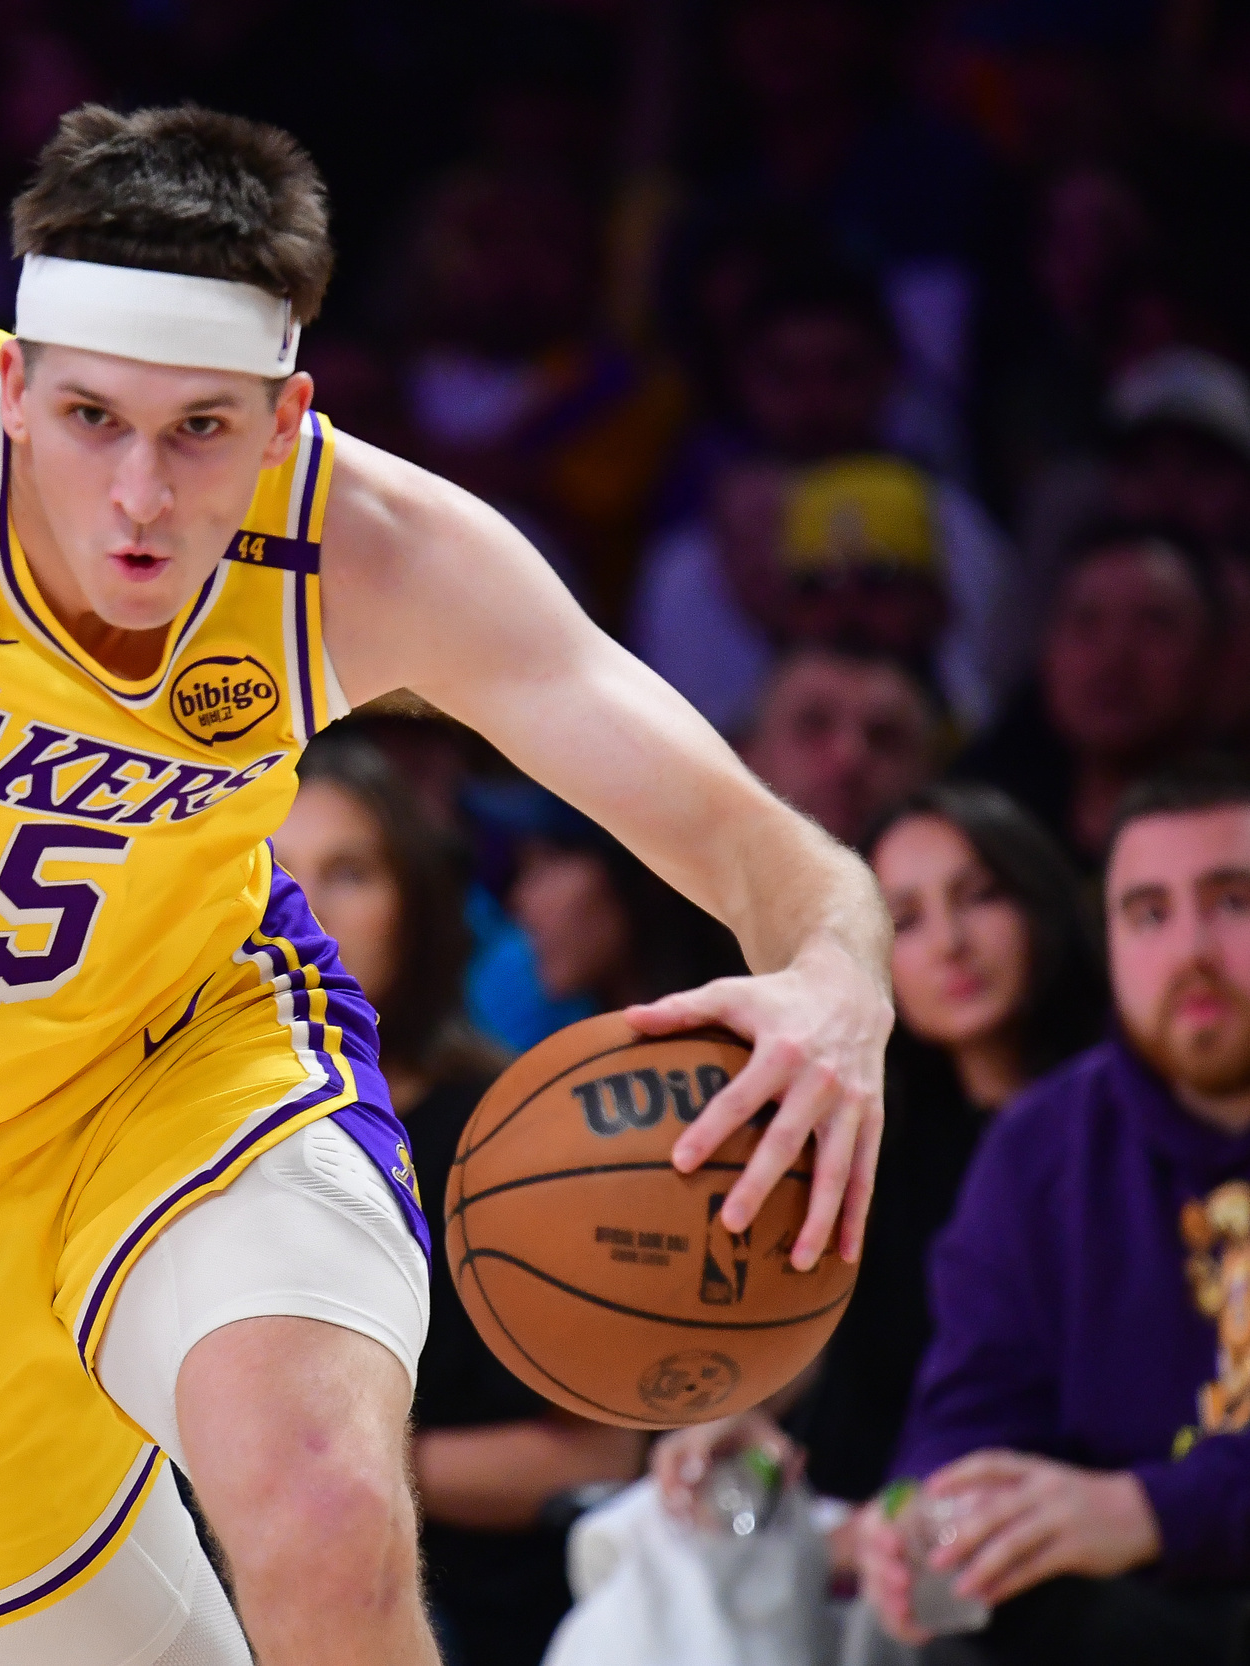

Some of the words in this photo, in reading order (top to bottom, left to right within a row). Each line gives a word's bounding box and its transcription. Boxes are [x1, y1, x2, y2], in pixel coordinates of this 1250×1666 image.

[238, 535, 266, 562] 44
[177, 677, 272, 717] bibigo
[571, 1064, 731, 1138] Wil
